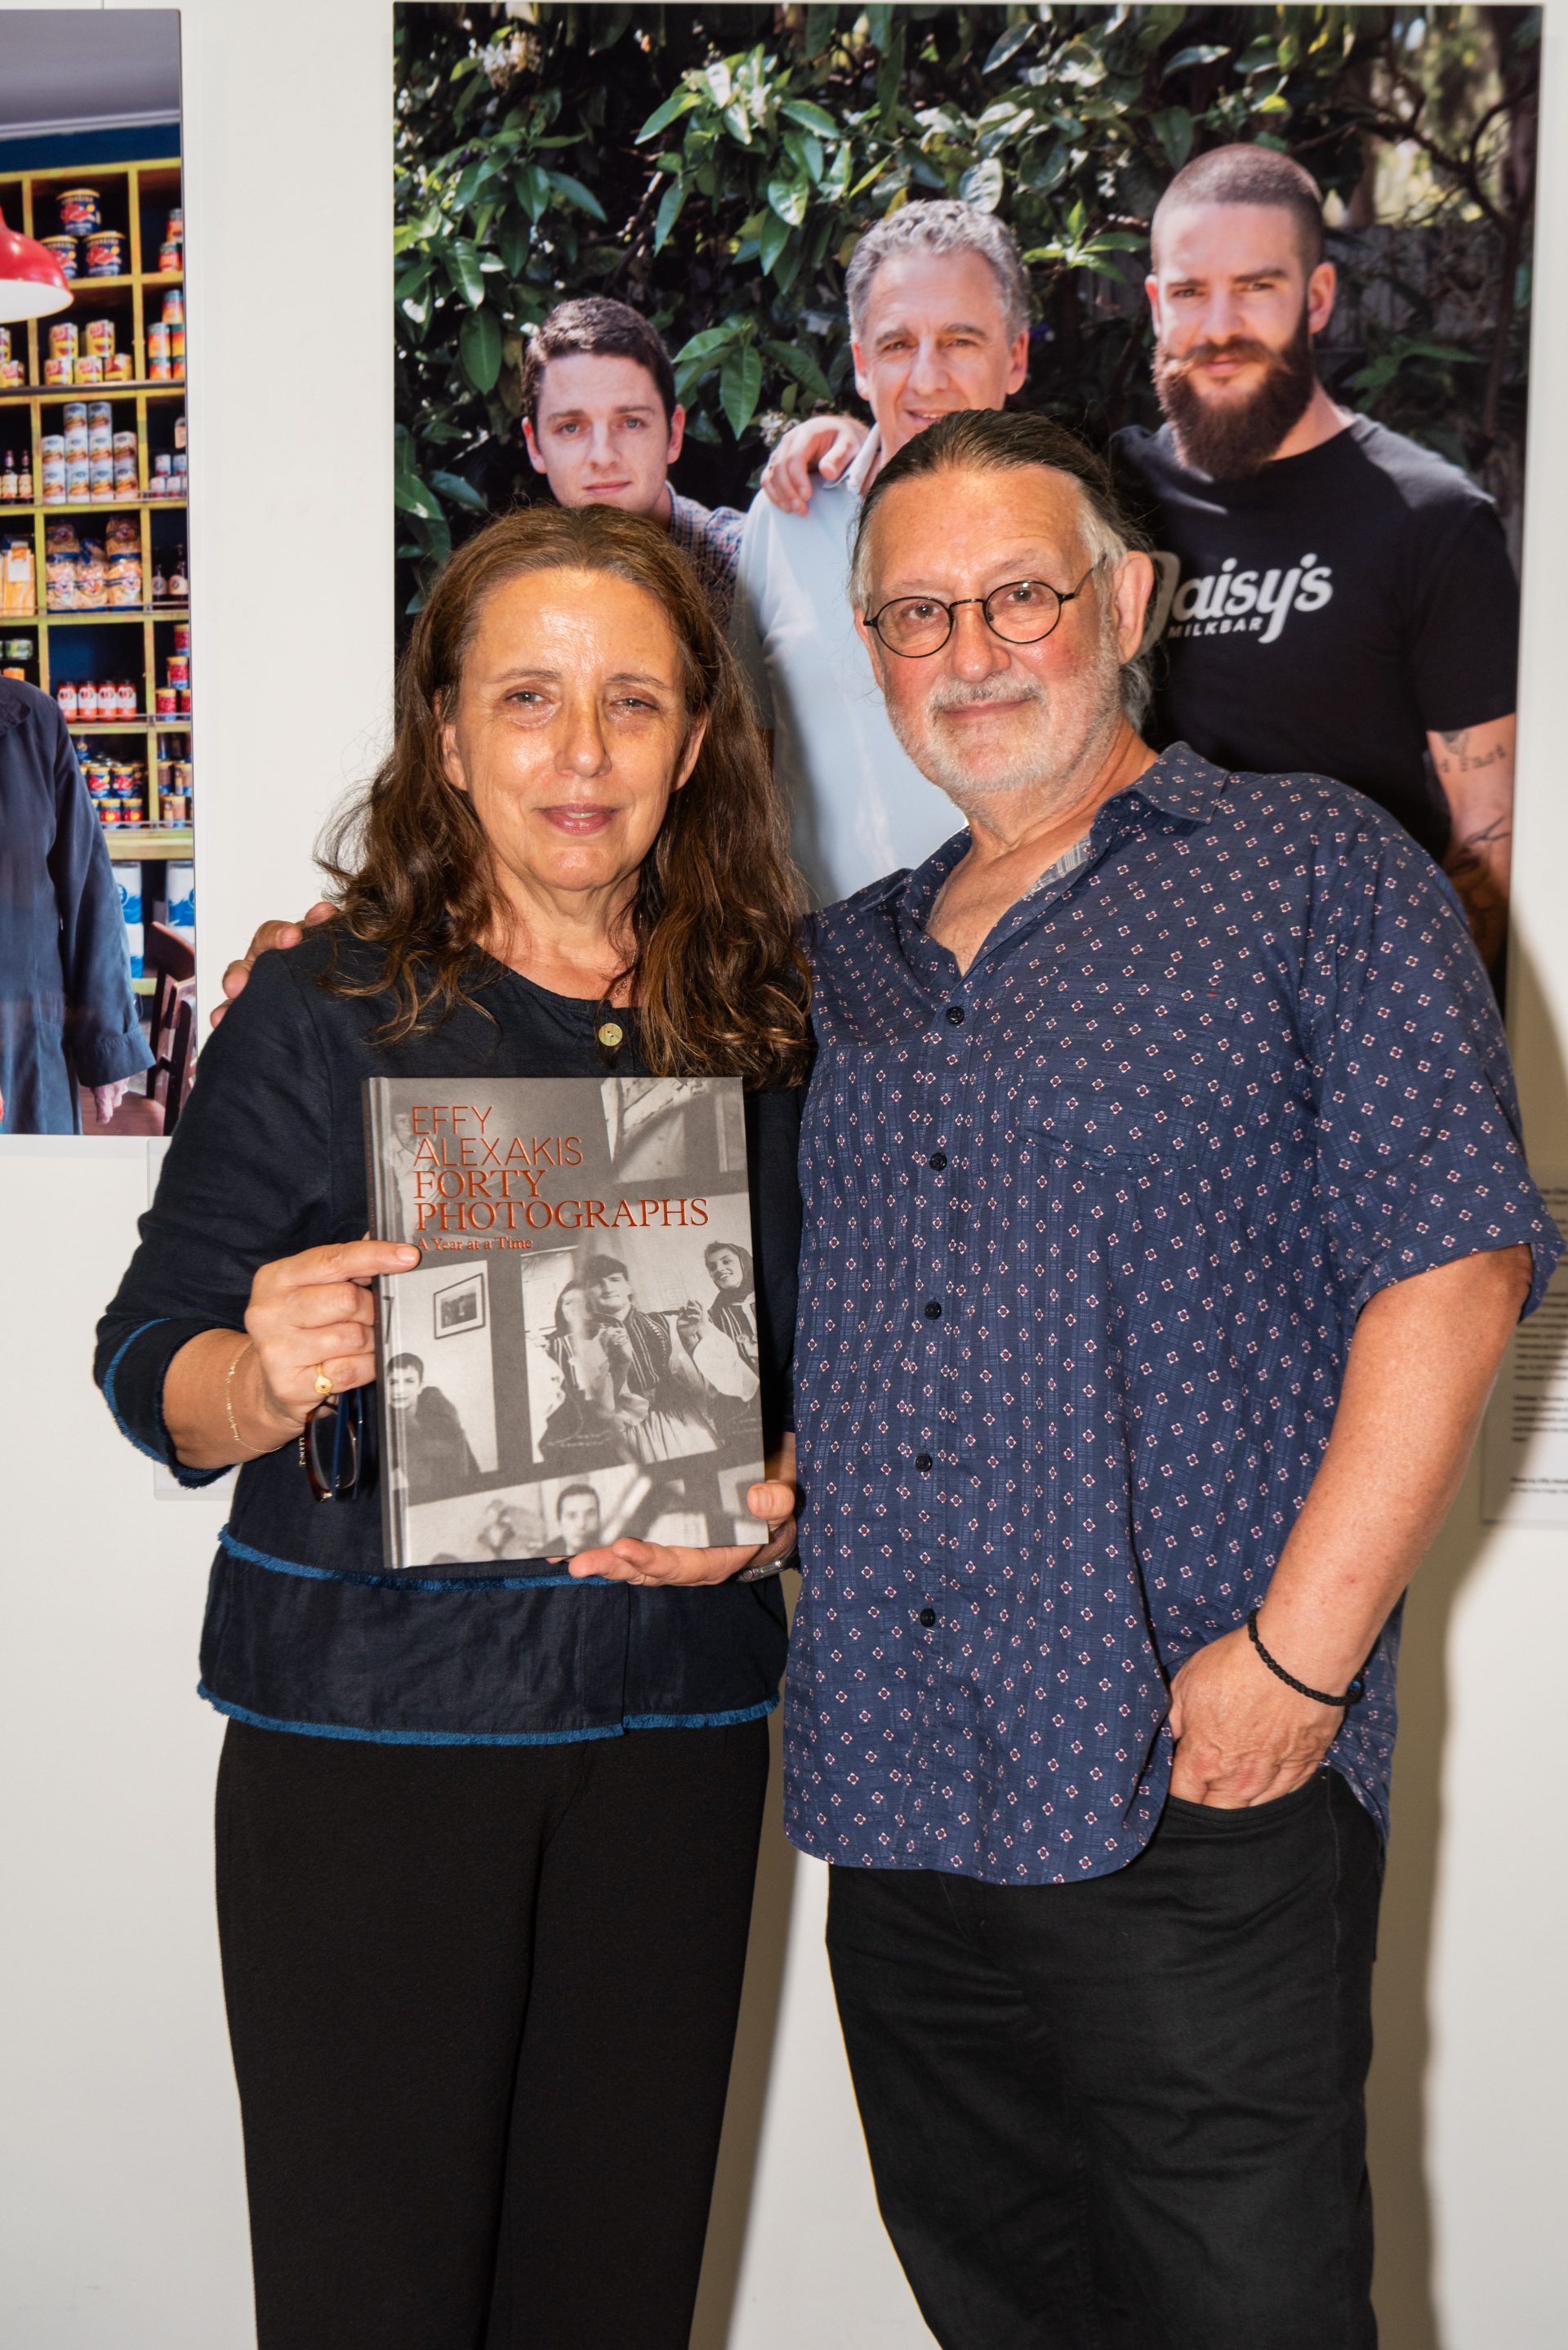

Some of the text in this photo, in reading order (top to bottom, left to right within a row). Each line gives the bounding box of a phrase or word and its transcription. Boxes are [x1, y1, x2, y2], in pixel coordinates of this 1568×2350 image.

[1168, 617, 1263, 637] MILKBAR
[412, 1106, 492, 1135] EFFY
[413, 1136, 583, 1166] ALEXAKIS
[412, 1170, 546, 1198] FORTY
[414, 1197, 709, 1231] PHOTOGRAPHS
[417, 1236, 532, 1251] A Year at a Time
